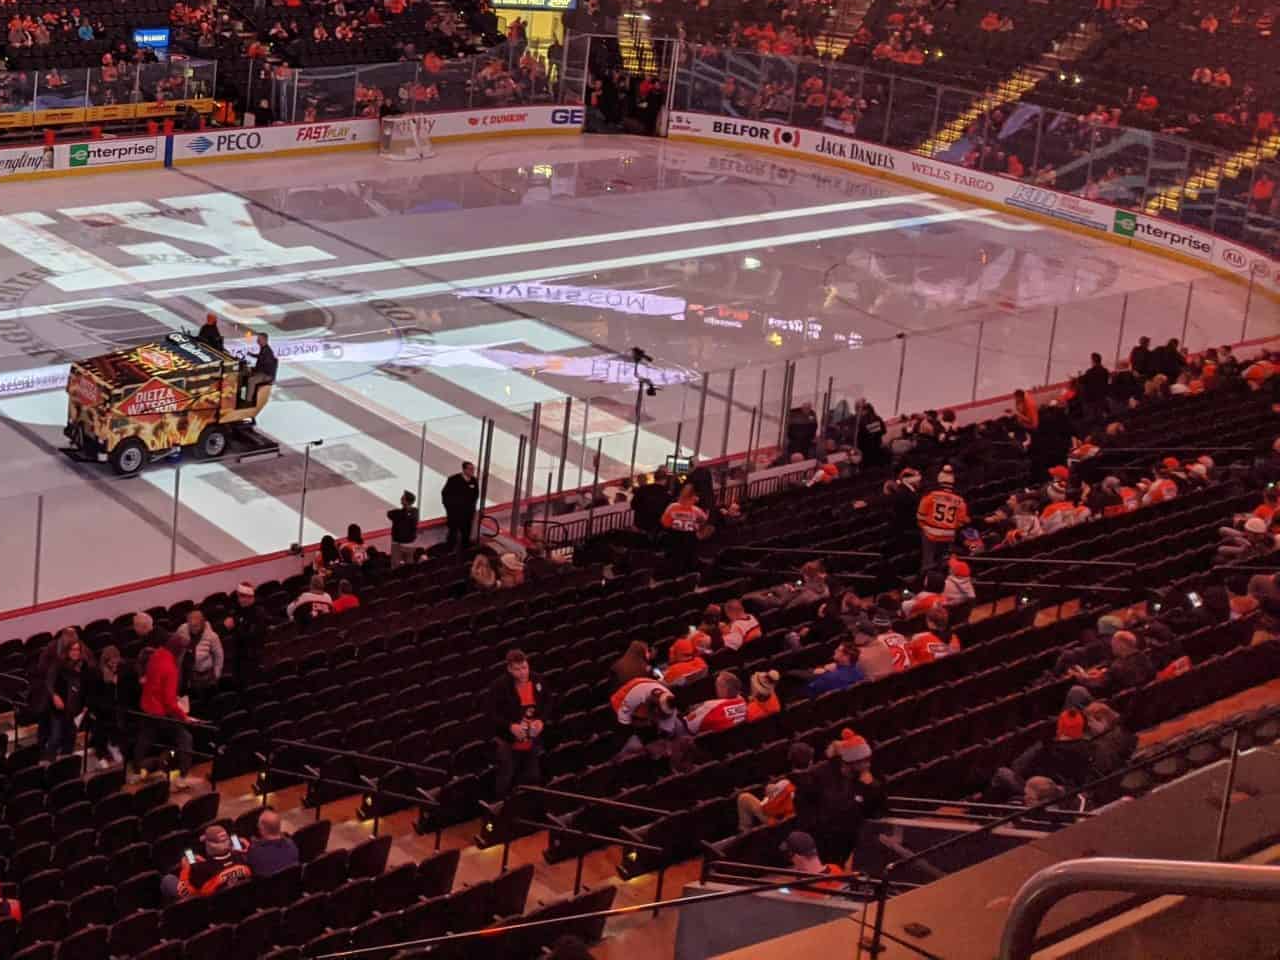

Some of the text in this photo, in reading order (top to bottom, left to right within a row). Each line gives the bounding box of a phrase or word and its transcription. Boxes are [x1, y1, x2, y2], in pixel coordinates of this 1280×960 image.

[551, 108, 585, 125] GE
[713, 120, 770, 140] BELFOR
[216, 131, 262, 152] PECO
[816, 136, 847, 158] JACK
[71, 142, 156, 164] enterprise
[911, 161, 995, 193] WELLS FARGO
[1120, 216, 1211, 254] enterprise
[135, 387, 164, 405] DIETZ
[933, 503, 959, 524] 53
